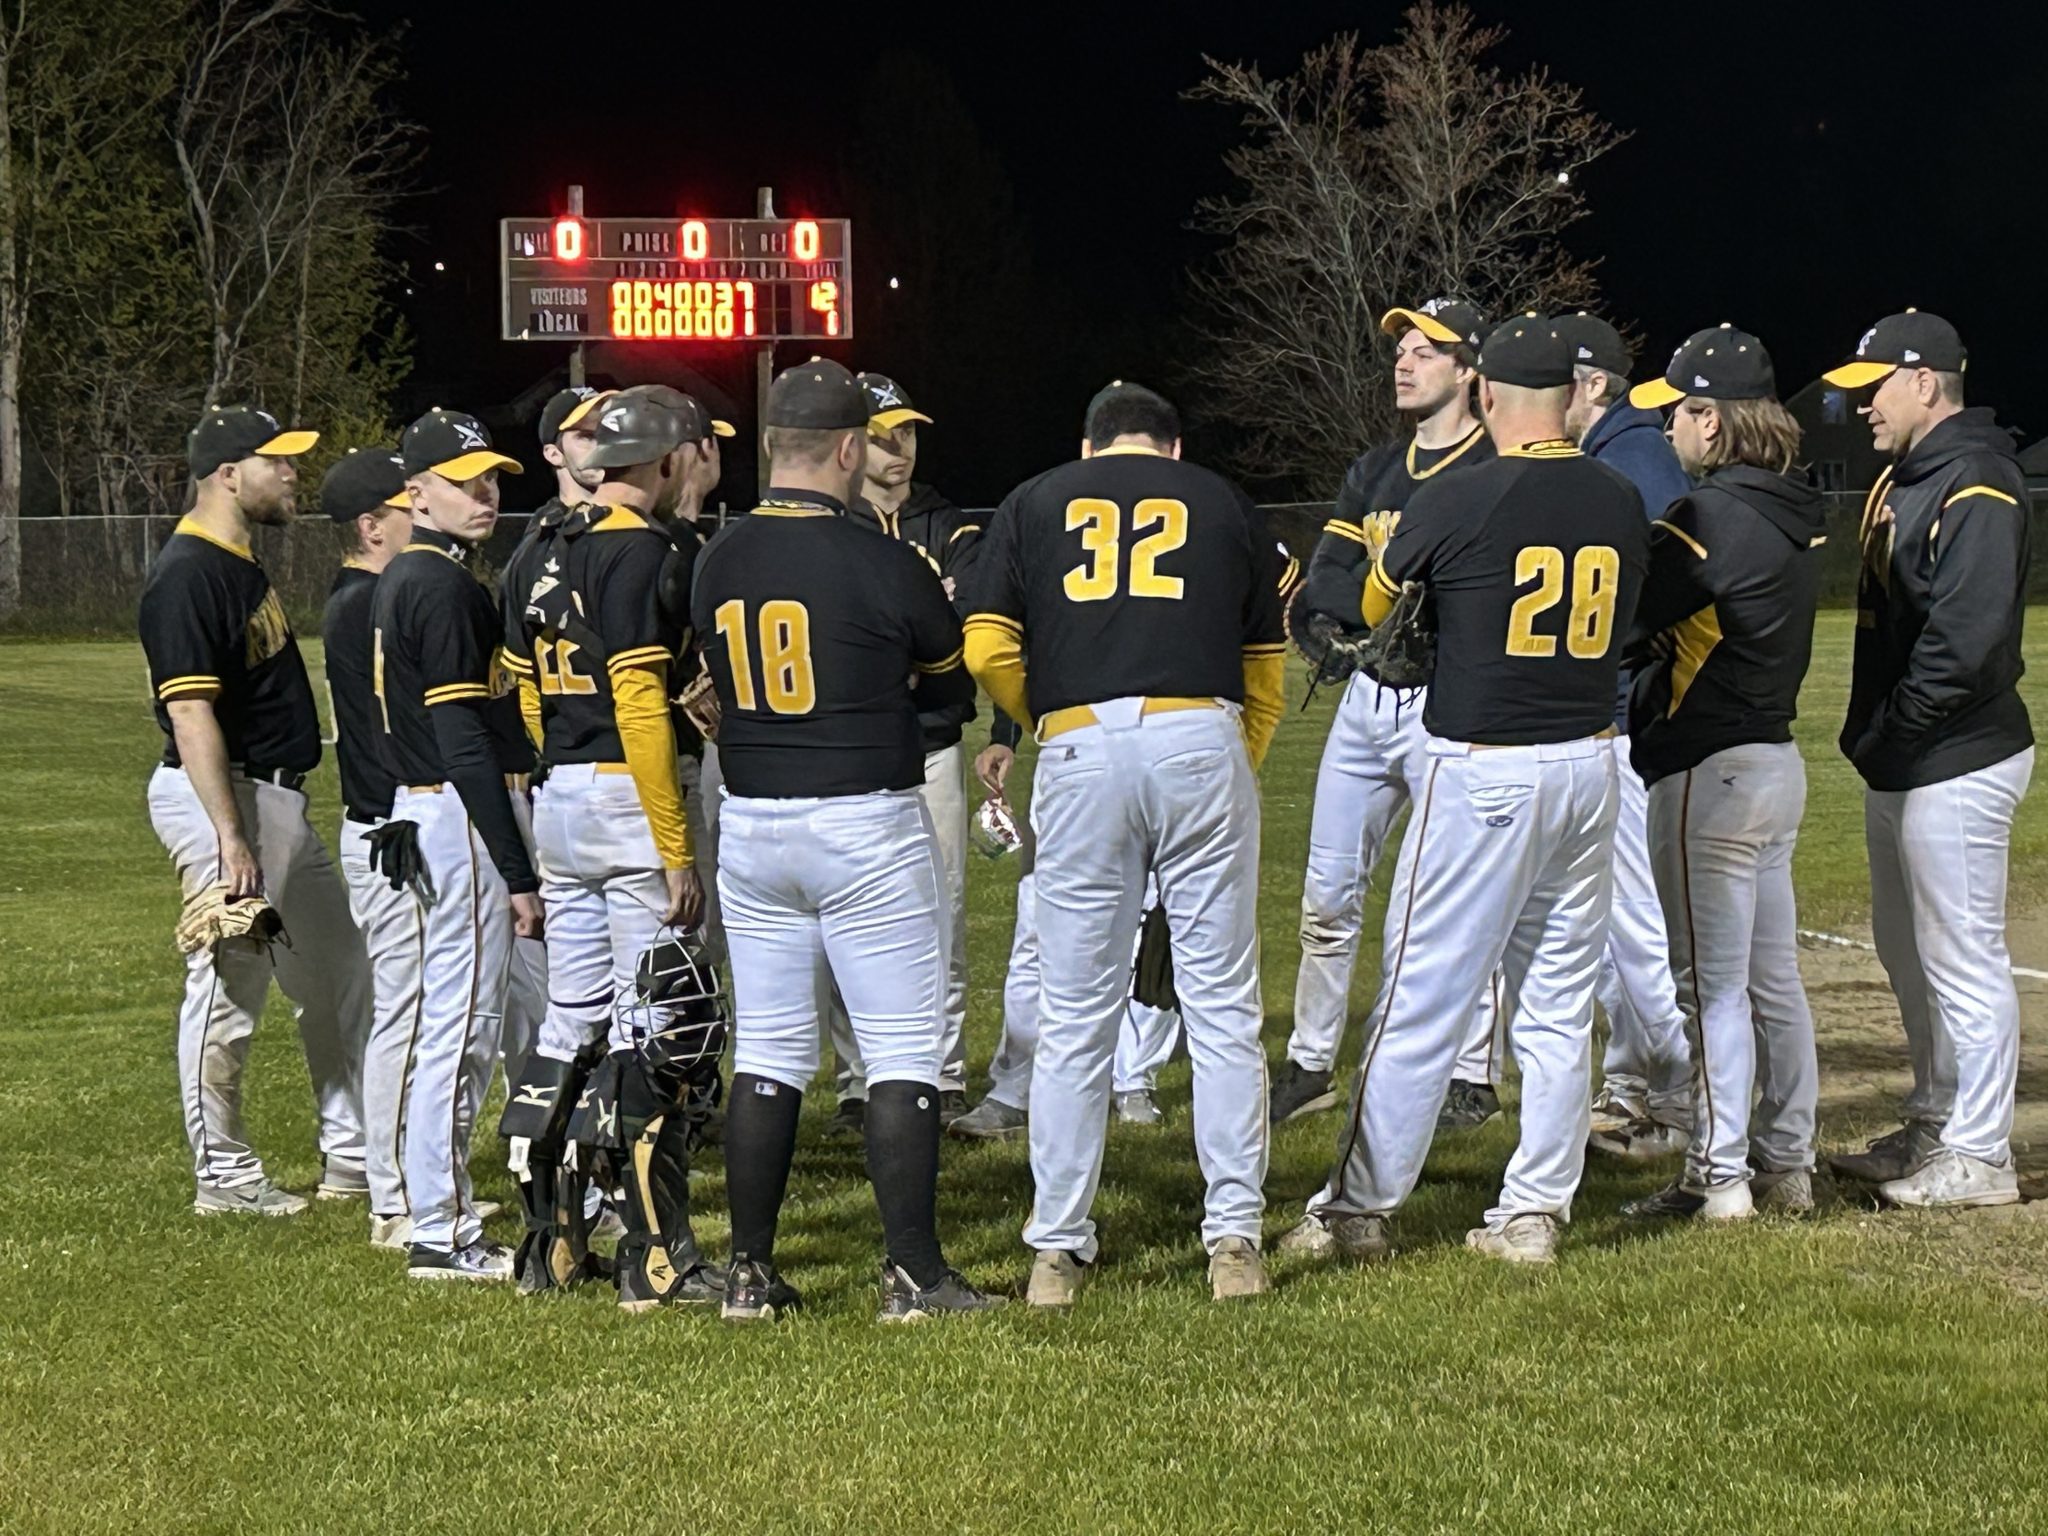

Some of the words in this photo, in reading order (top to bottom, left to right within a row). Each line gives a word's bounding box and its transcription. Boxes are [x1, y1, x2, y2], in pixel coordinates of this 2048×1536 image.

[556, 221, 582, 259] 0
[682, 221, 707, 259] 0
[794, 221, 819, 259] 0
[1063, 498, 1189, 602] 32
[1505, 545, 1620, 659] 28
[715, 599, 816, 714] 18
